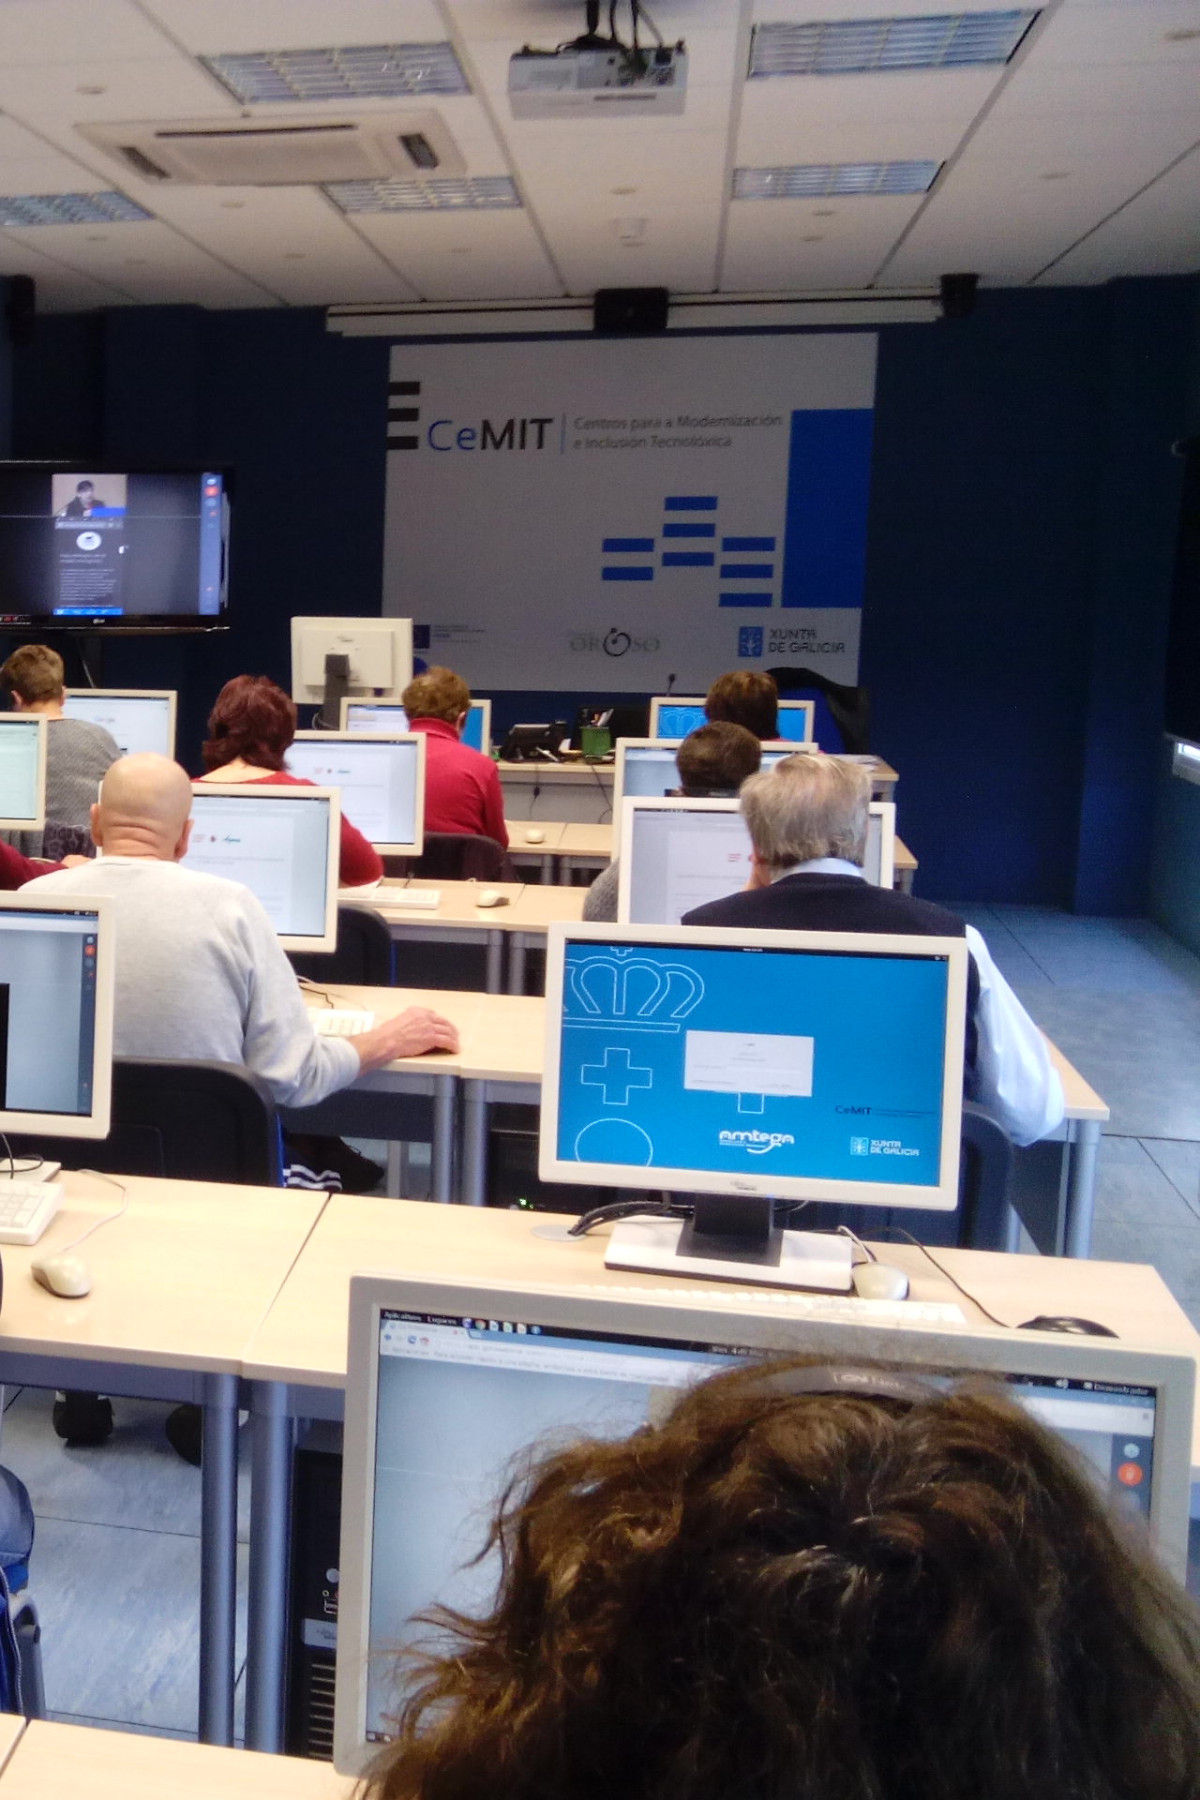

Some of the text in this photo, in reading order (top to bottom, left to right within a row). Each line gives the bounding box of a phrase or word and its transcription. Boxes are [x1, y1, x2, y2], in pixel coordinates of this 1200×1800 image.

[573, 417, 628, 430] Centros
[630, 417, 662, 431] para
[427, 418, 554, 451] CeMIT
[769, 628, 817, 640] XUNTA
[768, 642, 846, 654] DE GALICIA
